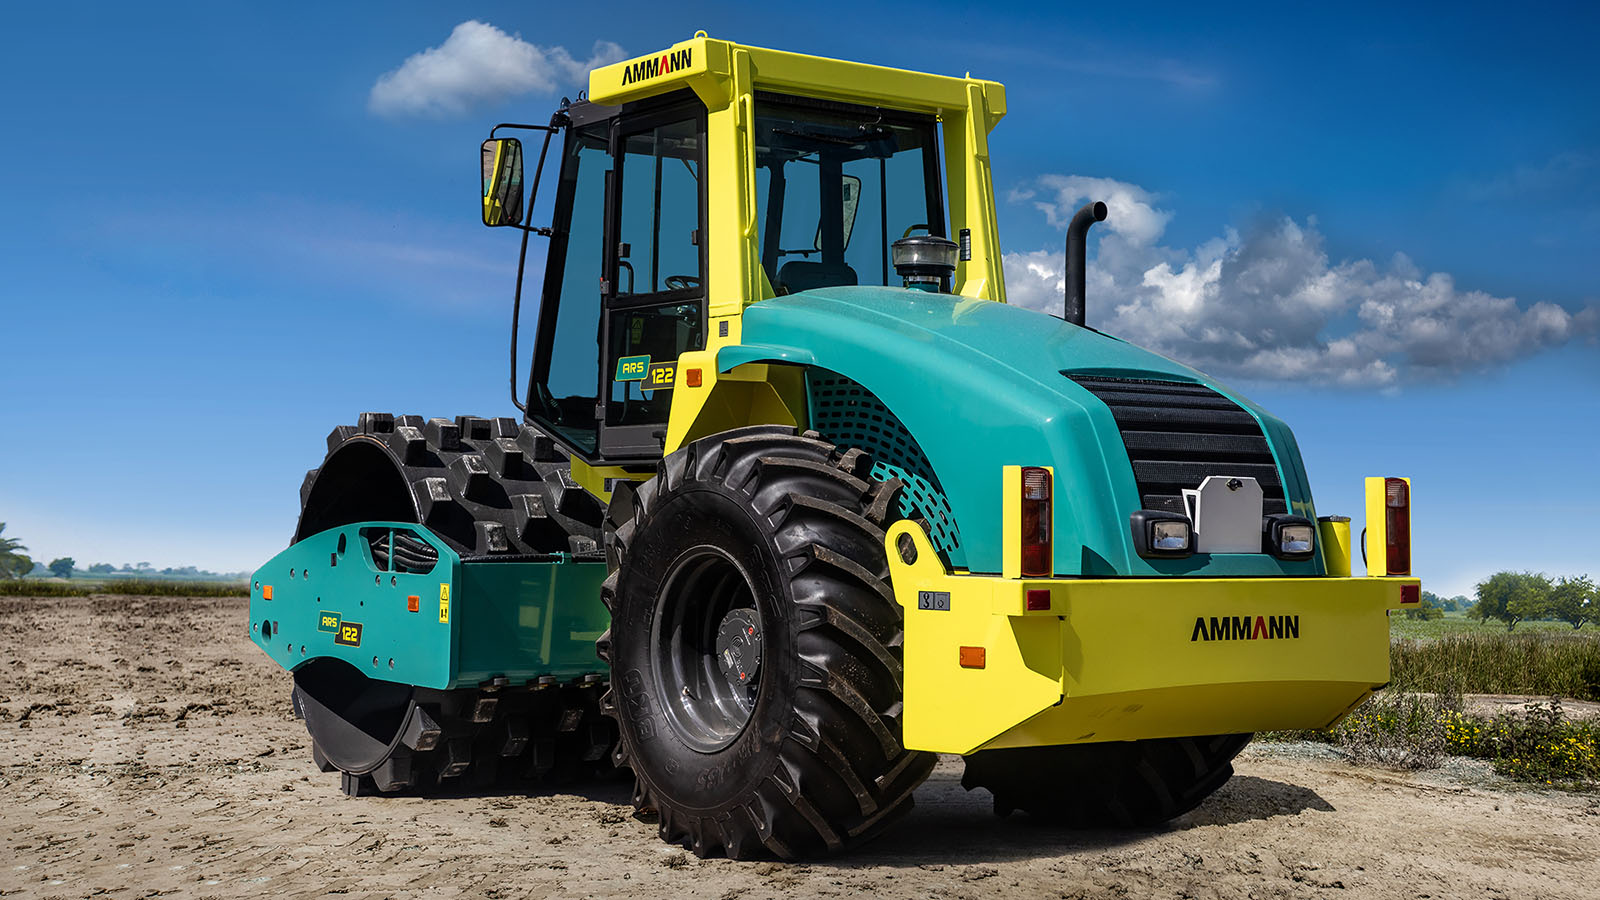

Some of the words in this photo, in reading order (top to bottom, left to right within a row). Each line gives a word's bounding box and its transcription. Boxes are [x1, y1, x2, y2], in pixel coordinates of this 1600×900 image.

[621, 47, 692, 86] AMMANN
[622, 361, 644, 374] ARS
[651, 367, 674, 385] 122
[322, 616, 338, 627] ARS
[1190, 615, 1299, 641] AMMANN
[342, 626, 358, 642] 122
